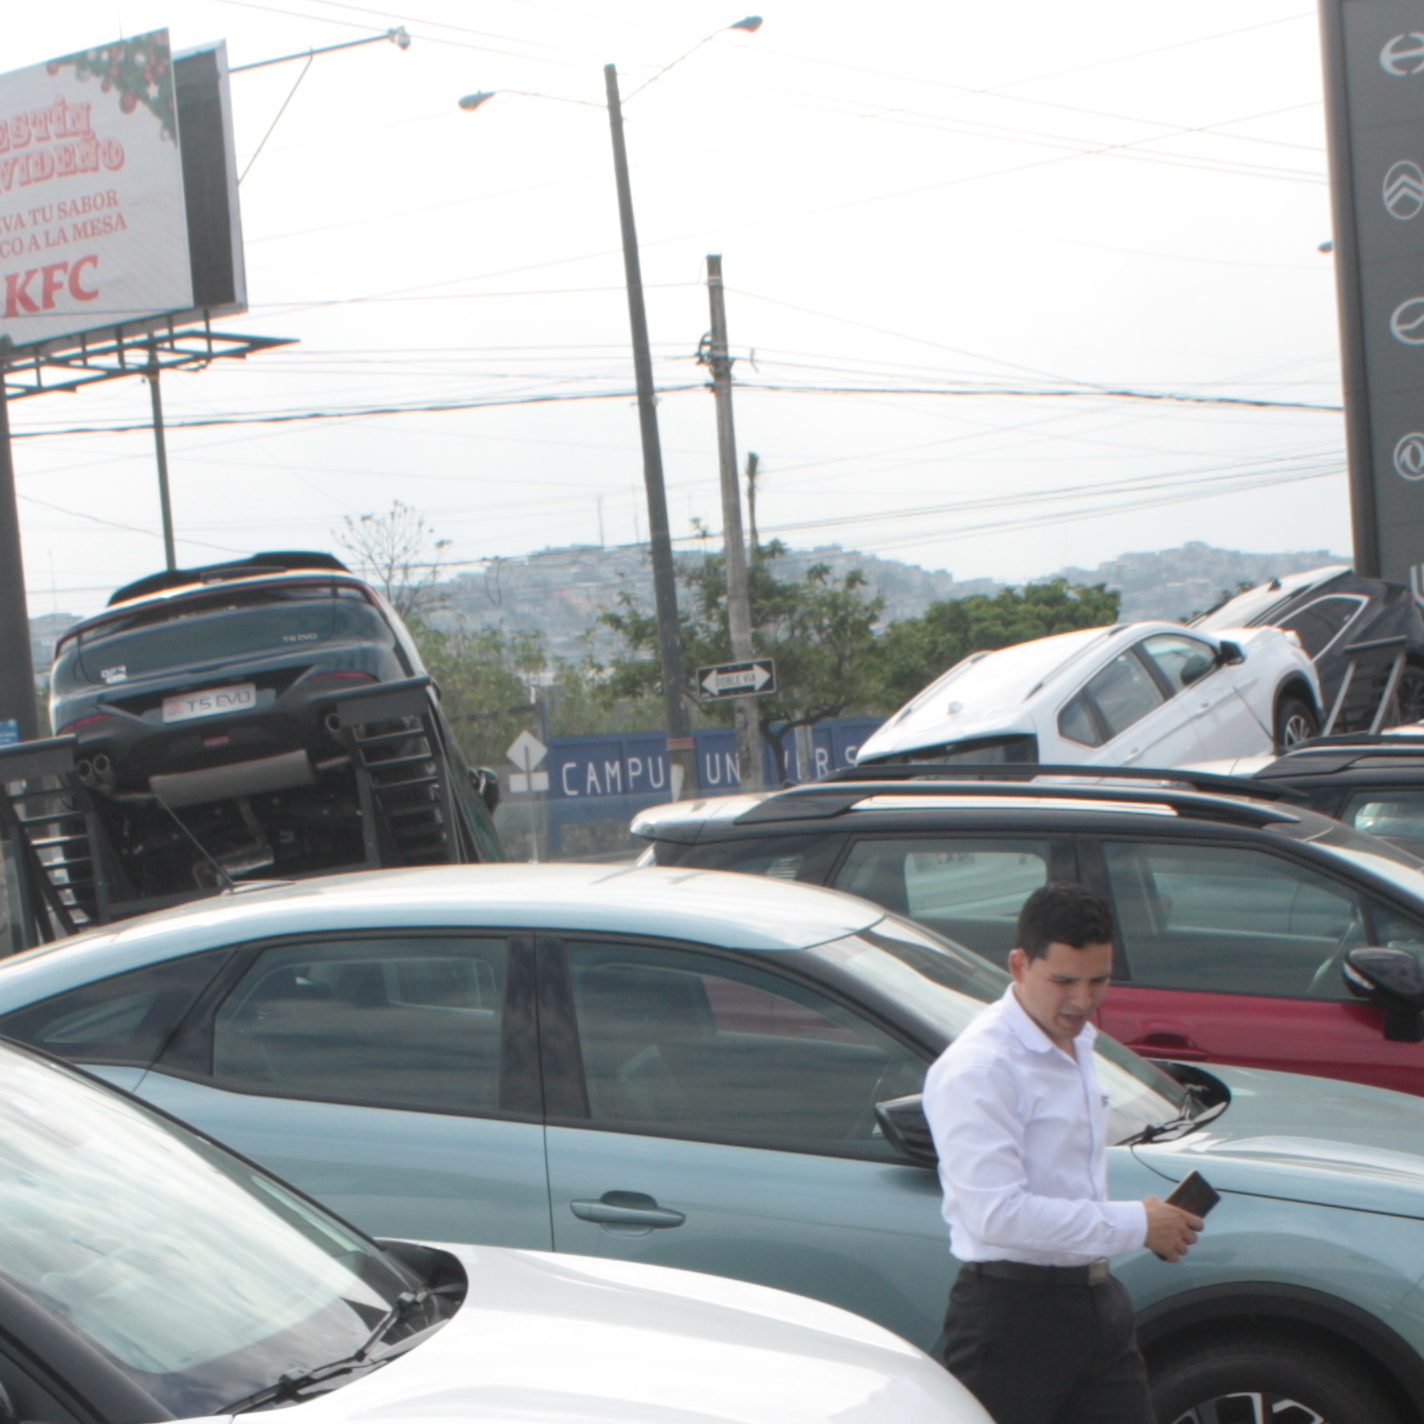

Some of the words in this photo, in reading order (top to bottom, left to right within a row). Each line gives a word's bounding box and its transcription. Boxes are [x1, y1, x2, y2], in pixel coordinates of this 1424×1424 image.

[28, 204, 54, 226] TU
[57, 189, 119, 220] SABOR
[28, 234, 42, 252] A
[44, 227, 69, 248] LA
[72, 213, 128, 241] MESA
[4, 254, 99, 317] KFC
[716, 674, 740, 688] DOBLE
[187, 698, 212, 712] T5
[562, 756, 665, 796] CAMPU
